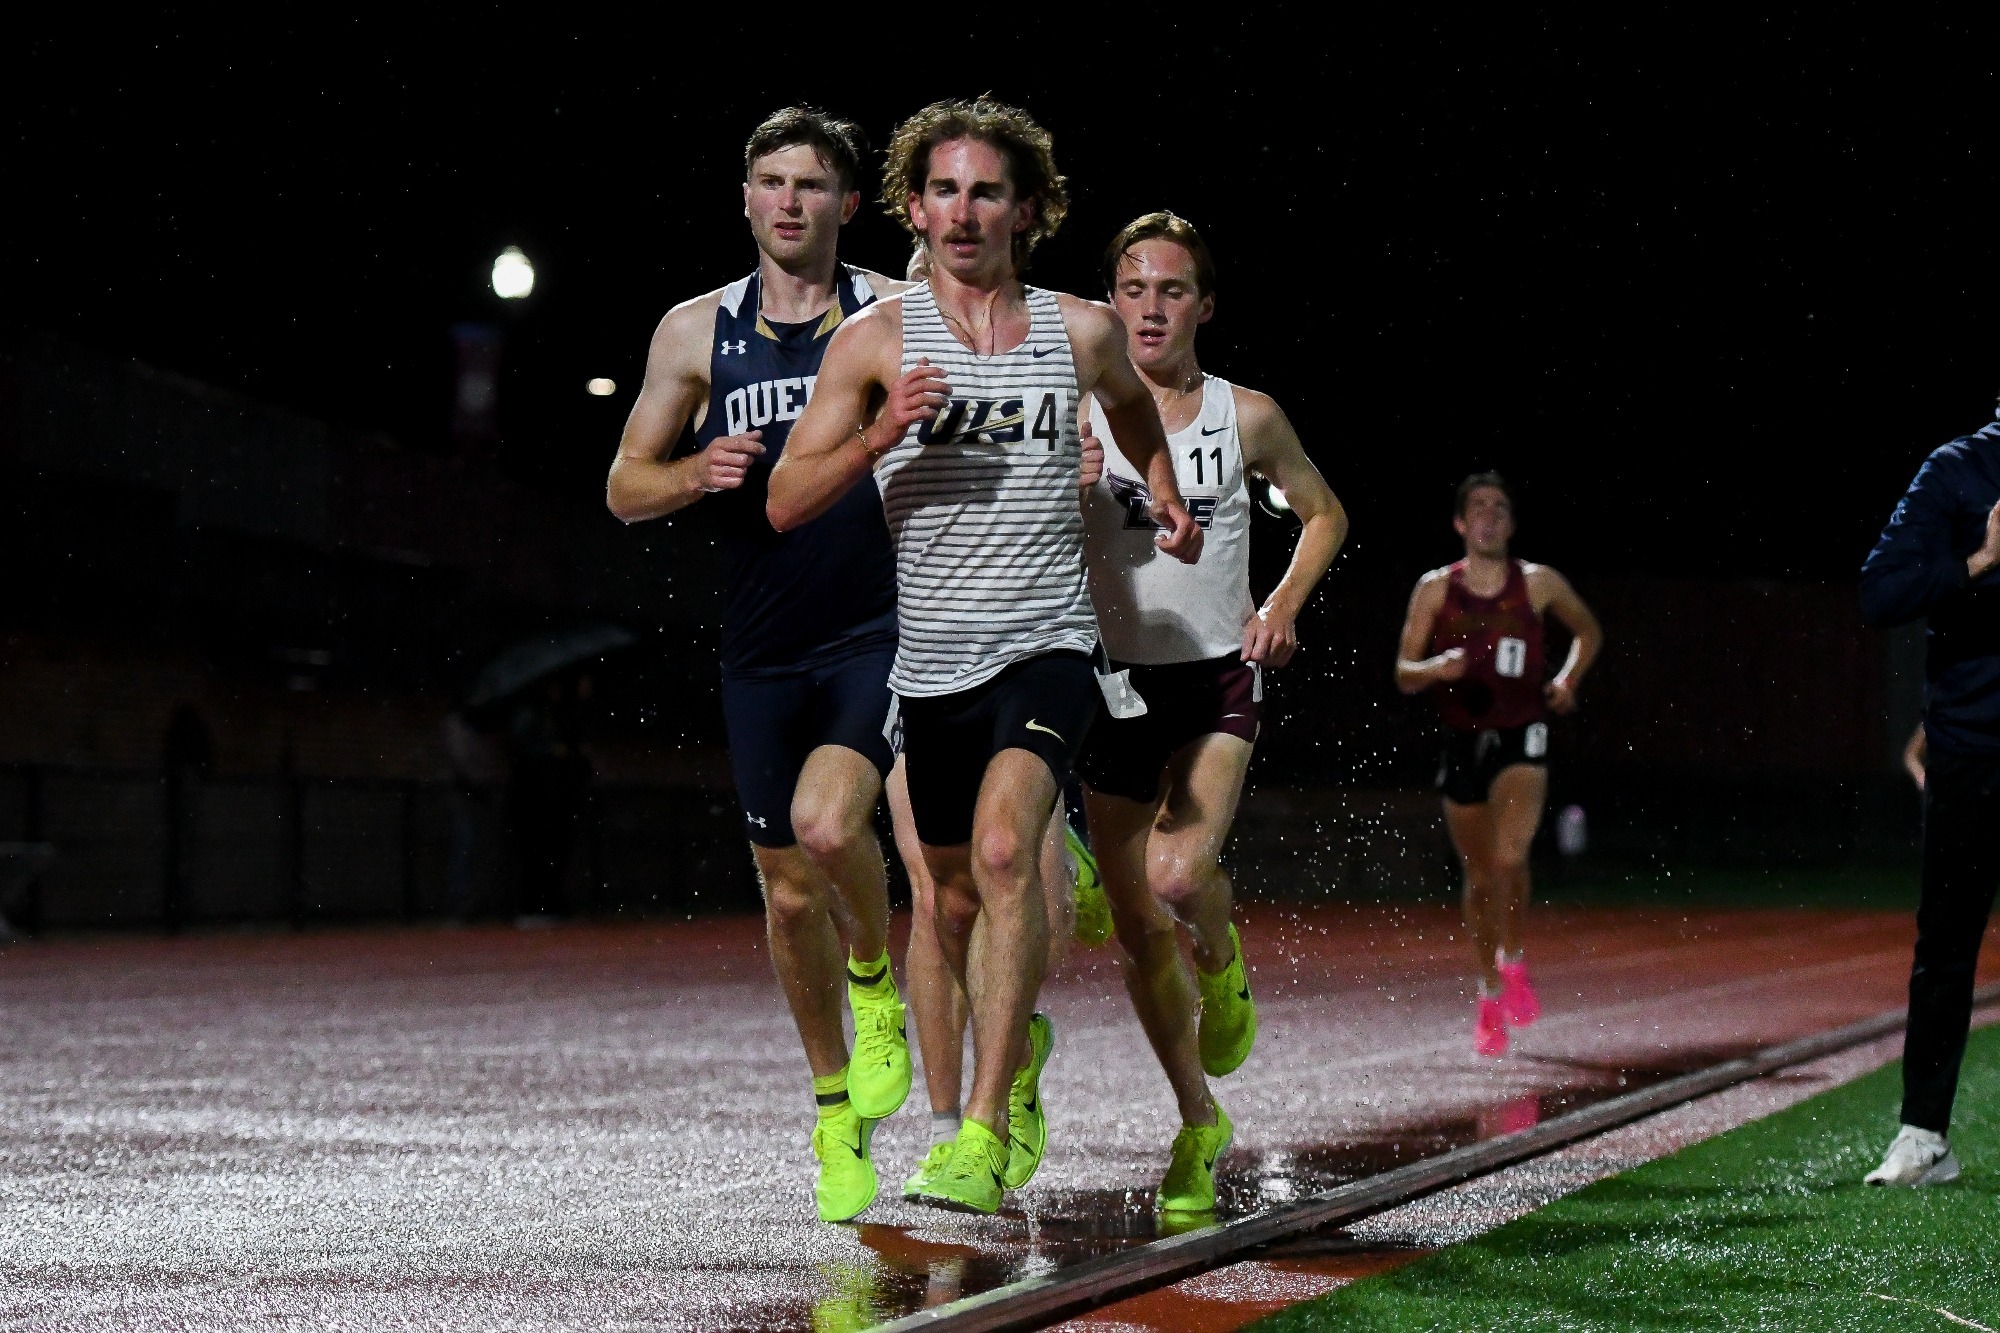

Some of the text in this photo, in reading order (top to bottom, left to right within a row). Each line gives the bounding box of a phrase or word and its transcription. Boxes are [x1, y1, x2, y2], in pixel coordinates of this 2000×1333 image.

[916, 399, 1025, 446] UIS
[1031, 392, 1060, 452] 4
[1188, 446, 1224, 486] 11
[1123, 495, 1220, 530] LE
